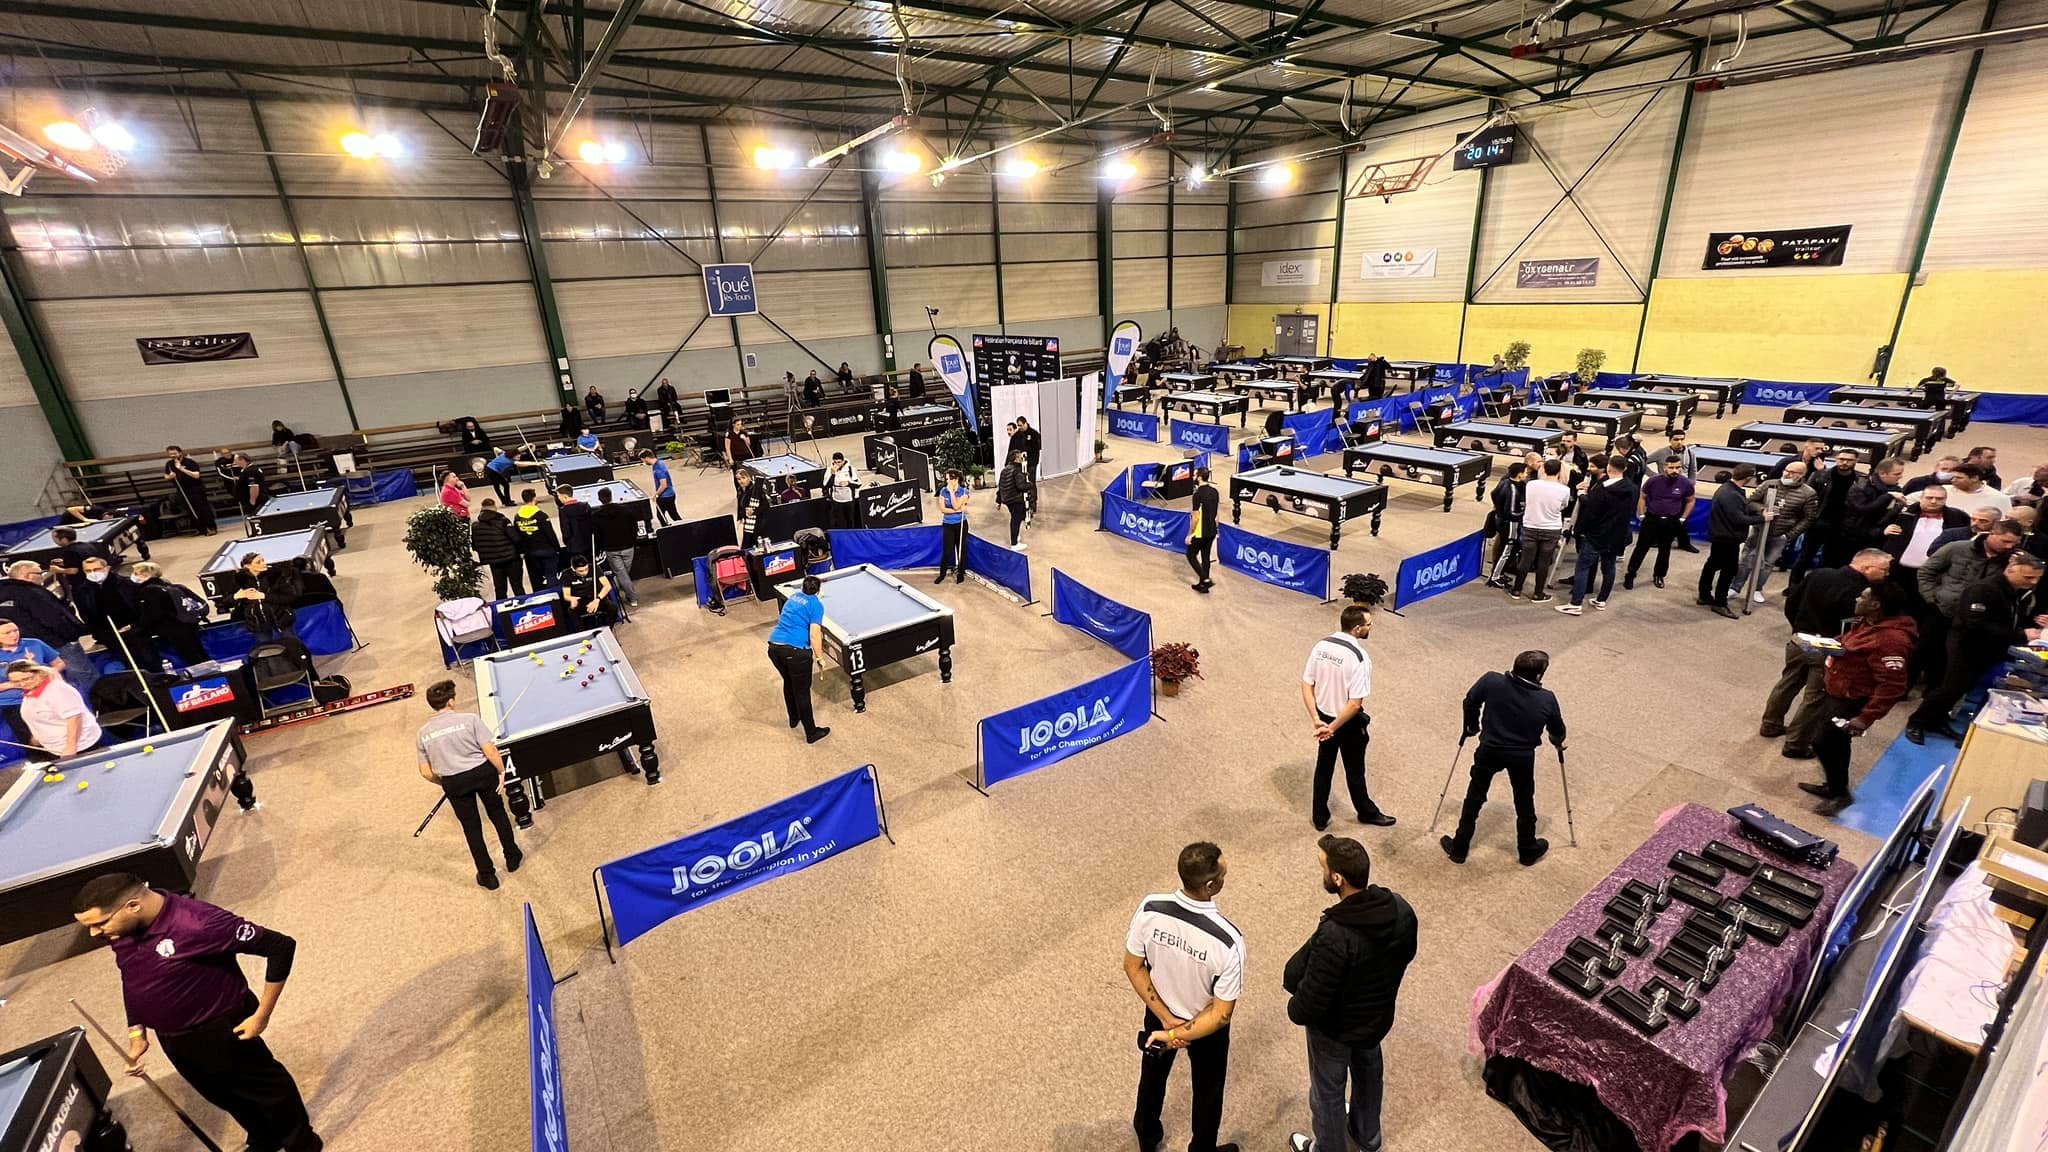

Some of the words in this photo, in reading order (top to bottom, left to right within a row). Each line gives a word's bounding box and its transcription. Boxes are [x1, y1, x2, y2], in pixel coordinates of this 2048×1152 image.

[1279, 262, 1300, 274] idex
[1756, 388, 1806, 401] JOOLA
[1116, 418, 1144, 433] JOOLA
[1181, 429, 1213, 446] JOOLA
[254, 524, 263, 536] 5
[1119, 511, 1166, 538] JOOLA
[1236, 544, 1295, 577] JOOLA
[1413, 557, 1459, 590] JOOLA
[206, 581, 216, 596] 9
[524, 615, 554, 630] BILLARD
[850, 650, 865, 671] 13
[178, 702, 191, 712] FF
[190, 686, 230, 706] BILLARD
[1019, 698, 1113, 755] JOOLA
[1030, 752, 1042, 761] for
[1043, 745, 1057, 753] the
[1058, 735, 1102, 750] Champion
[671, 818, 812, 895] JOOLA
[690, 887, 708, 899] for
[712, 878, 732, 890] the
[735, 856, 796, 880] Champion
[811, 839, 837, 861] you!
[1152, 928, 1208, 962] FFBillard
